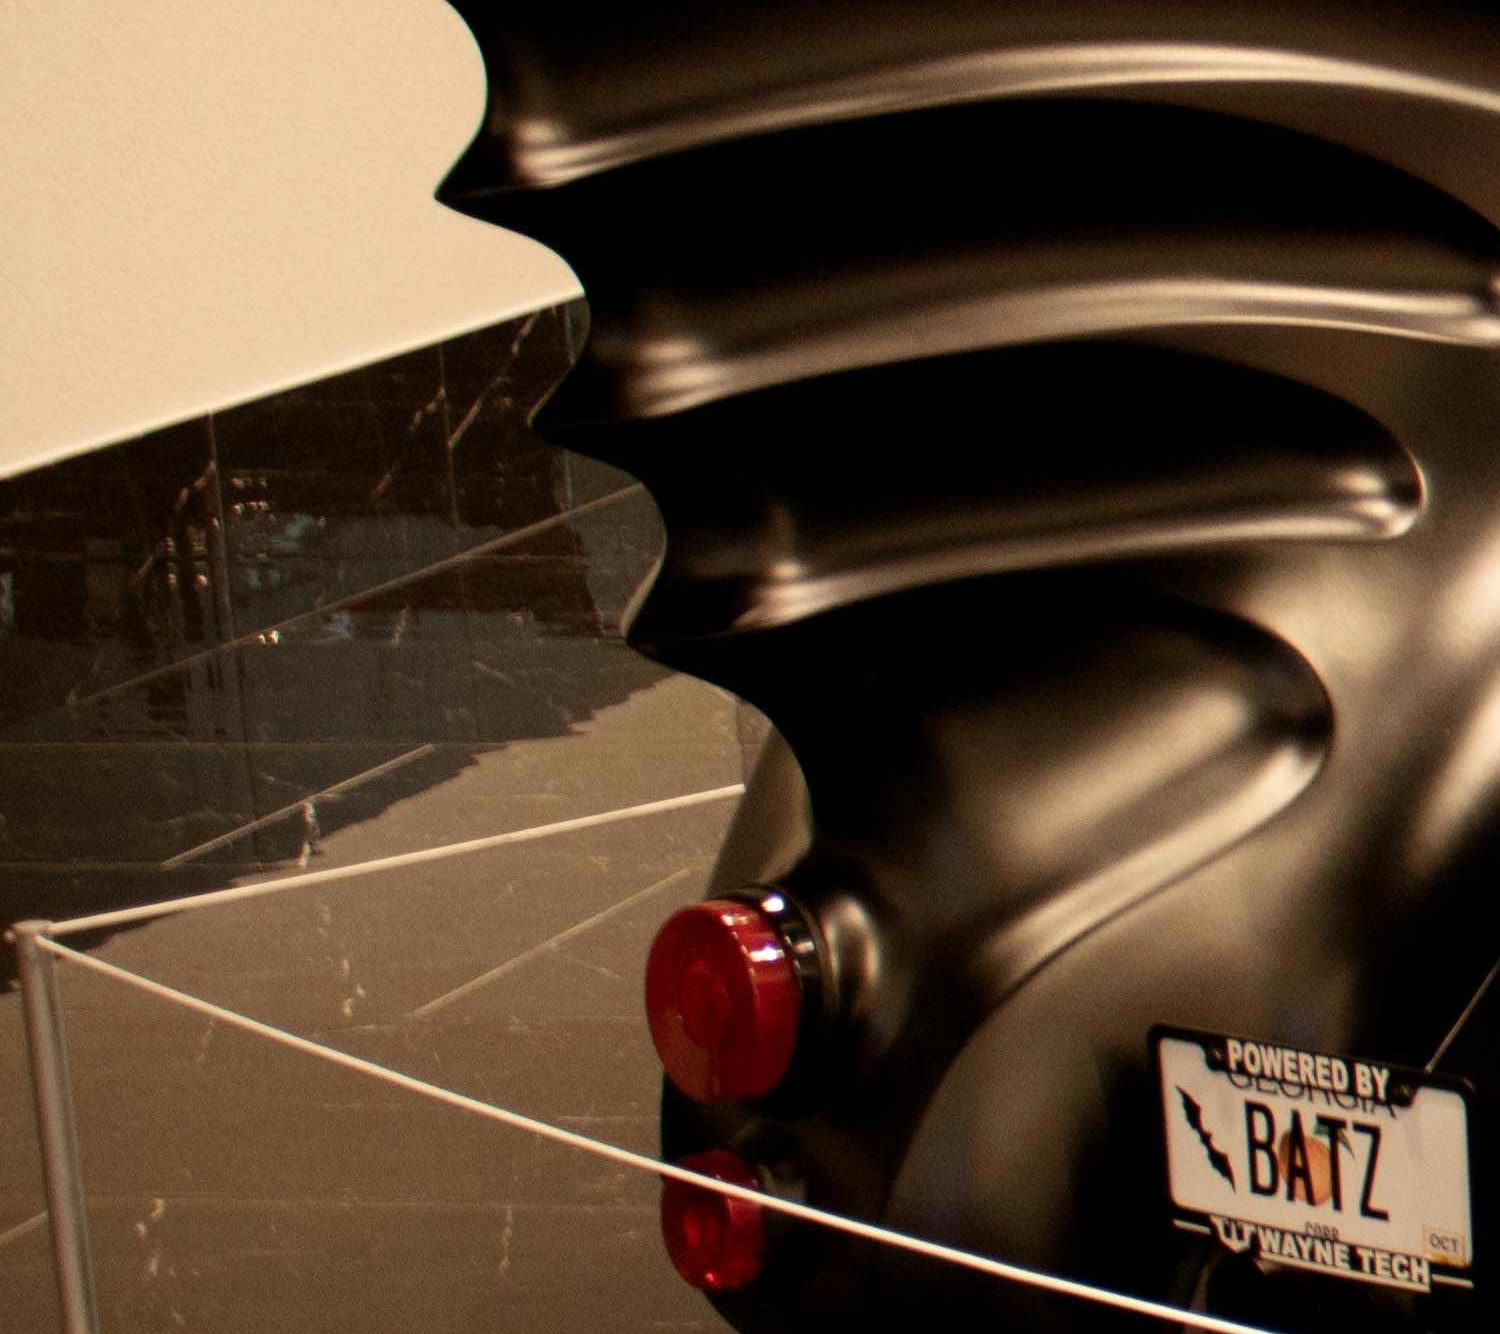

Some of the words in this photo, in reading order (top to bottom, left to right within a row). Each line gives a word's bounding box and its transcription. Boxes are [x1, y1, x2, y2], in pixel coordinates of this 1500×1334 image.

[1226, 1038, 1349, 1094] POWERED
[1353, 1062, 1390, 1102] BY
[1244, 1099, 1390, 1222] BATZ
[1257, 1225, 1350, 1270] WAYNE
[1356, 1244, 1431, 1285] TECH
[1429, 1231, 1459, 1254] OCT
